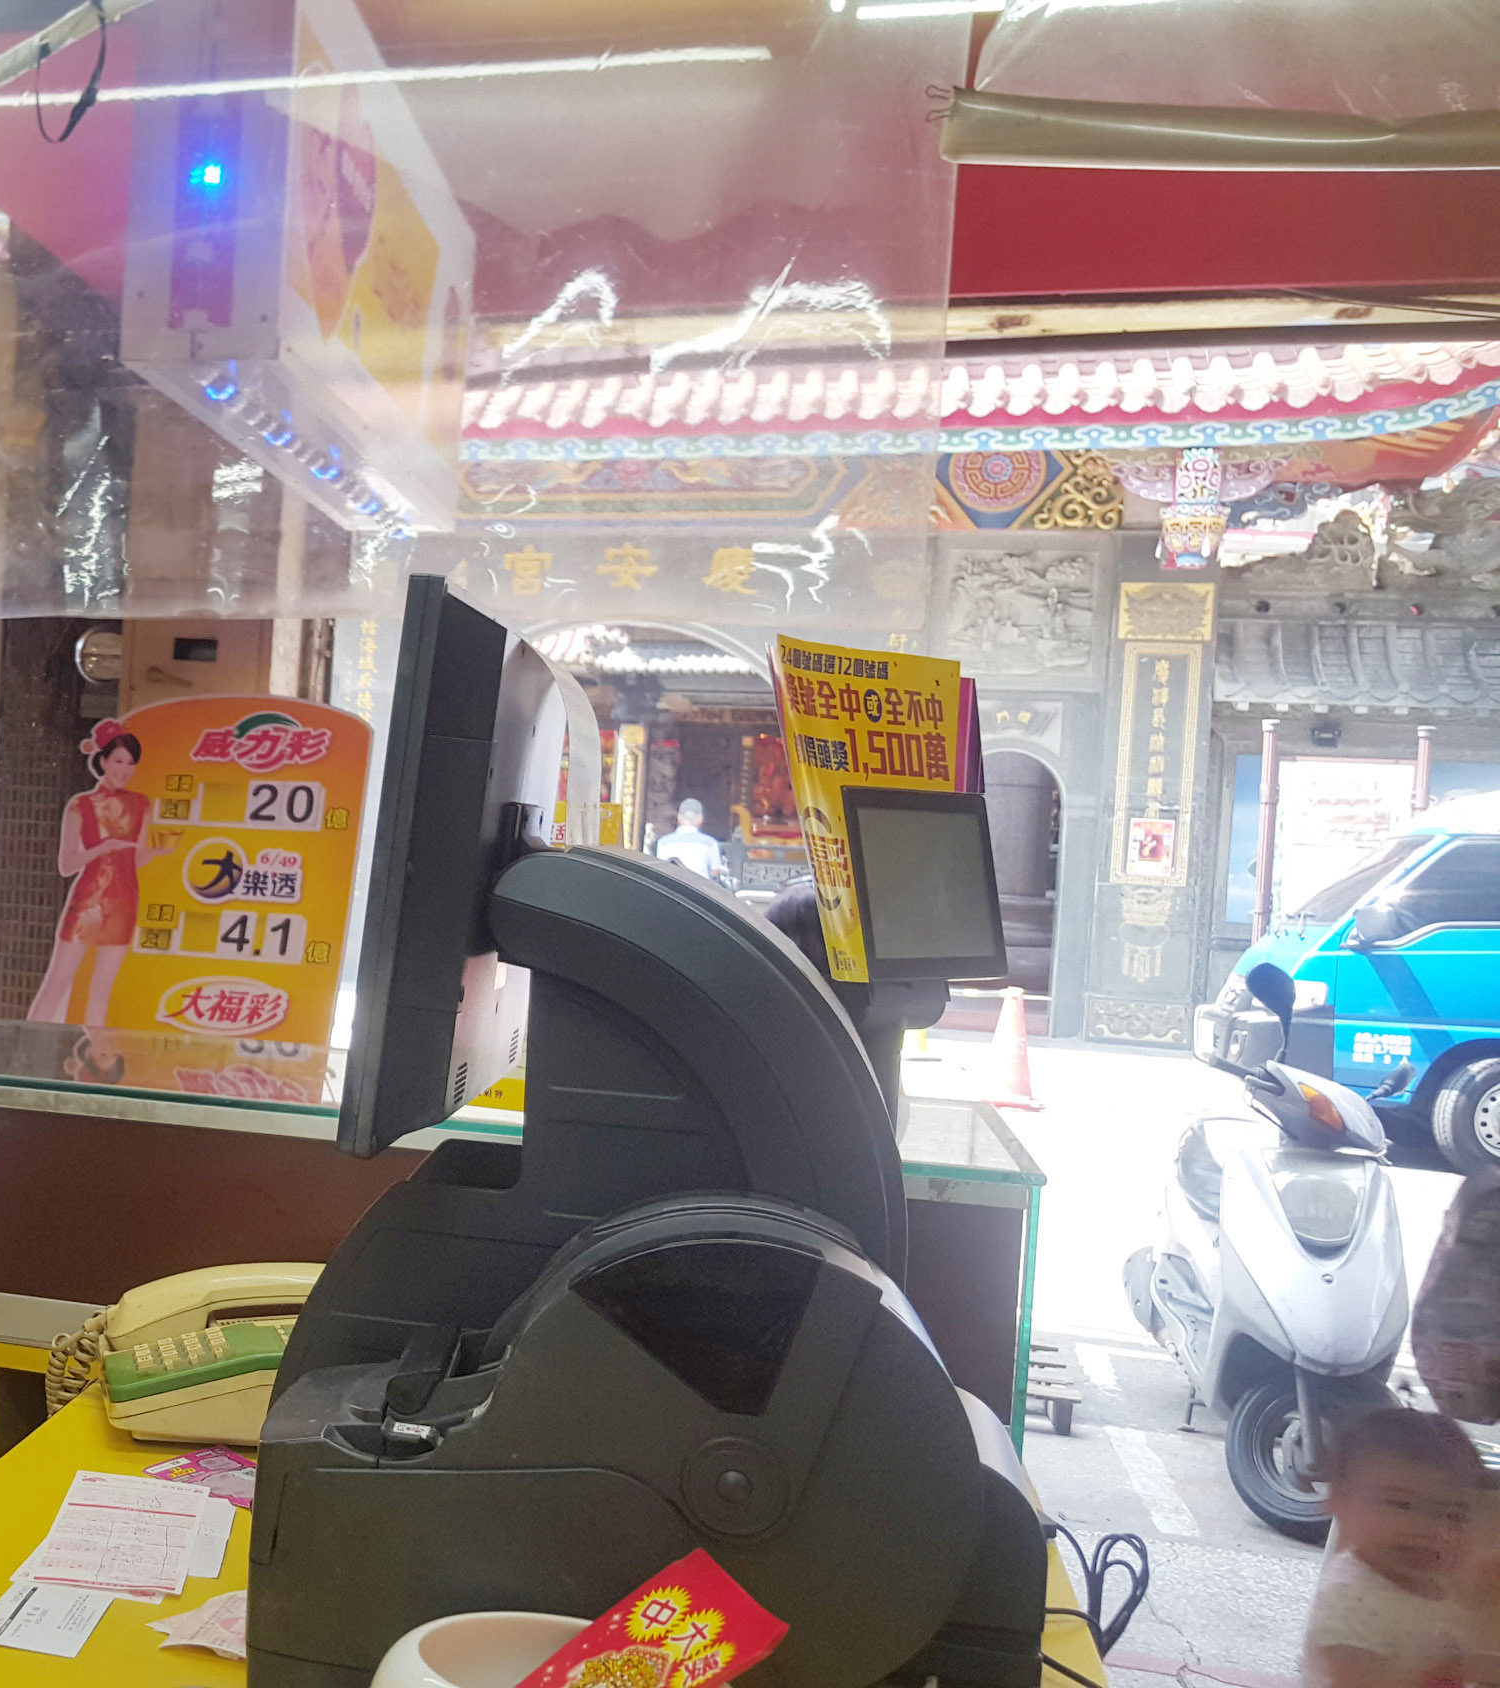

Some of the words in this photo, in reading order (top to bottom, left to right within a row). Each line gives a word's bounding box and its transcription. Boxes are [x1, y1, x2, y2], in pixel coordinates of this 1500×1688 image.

[191, 727, 331, 771] 威力彩
[249, 784, 314, 823] 20
[260, 853, 297, 867] 6/49
[220, 914, 292, 956] 4.1
[163, 986, 283, 1025] 大福彩
